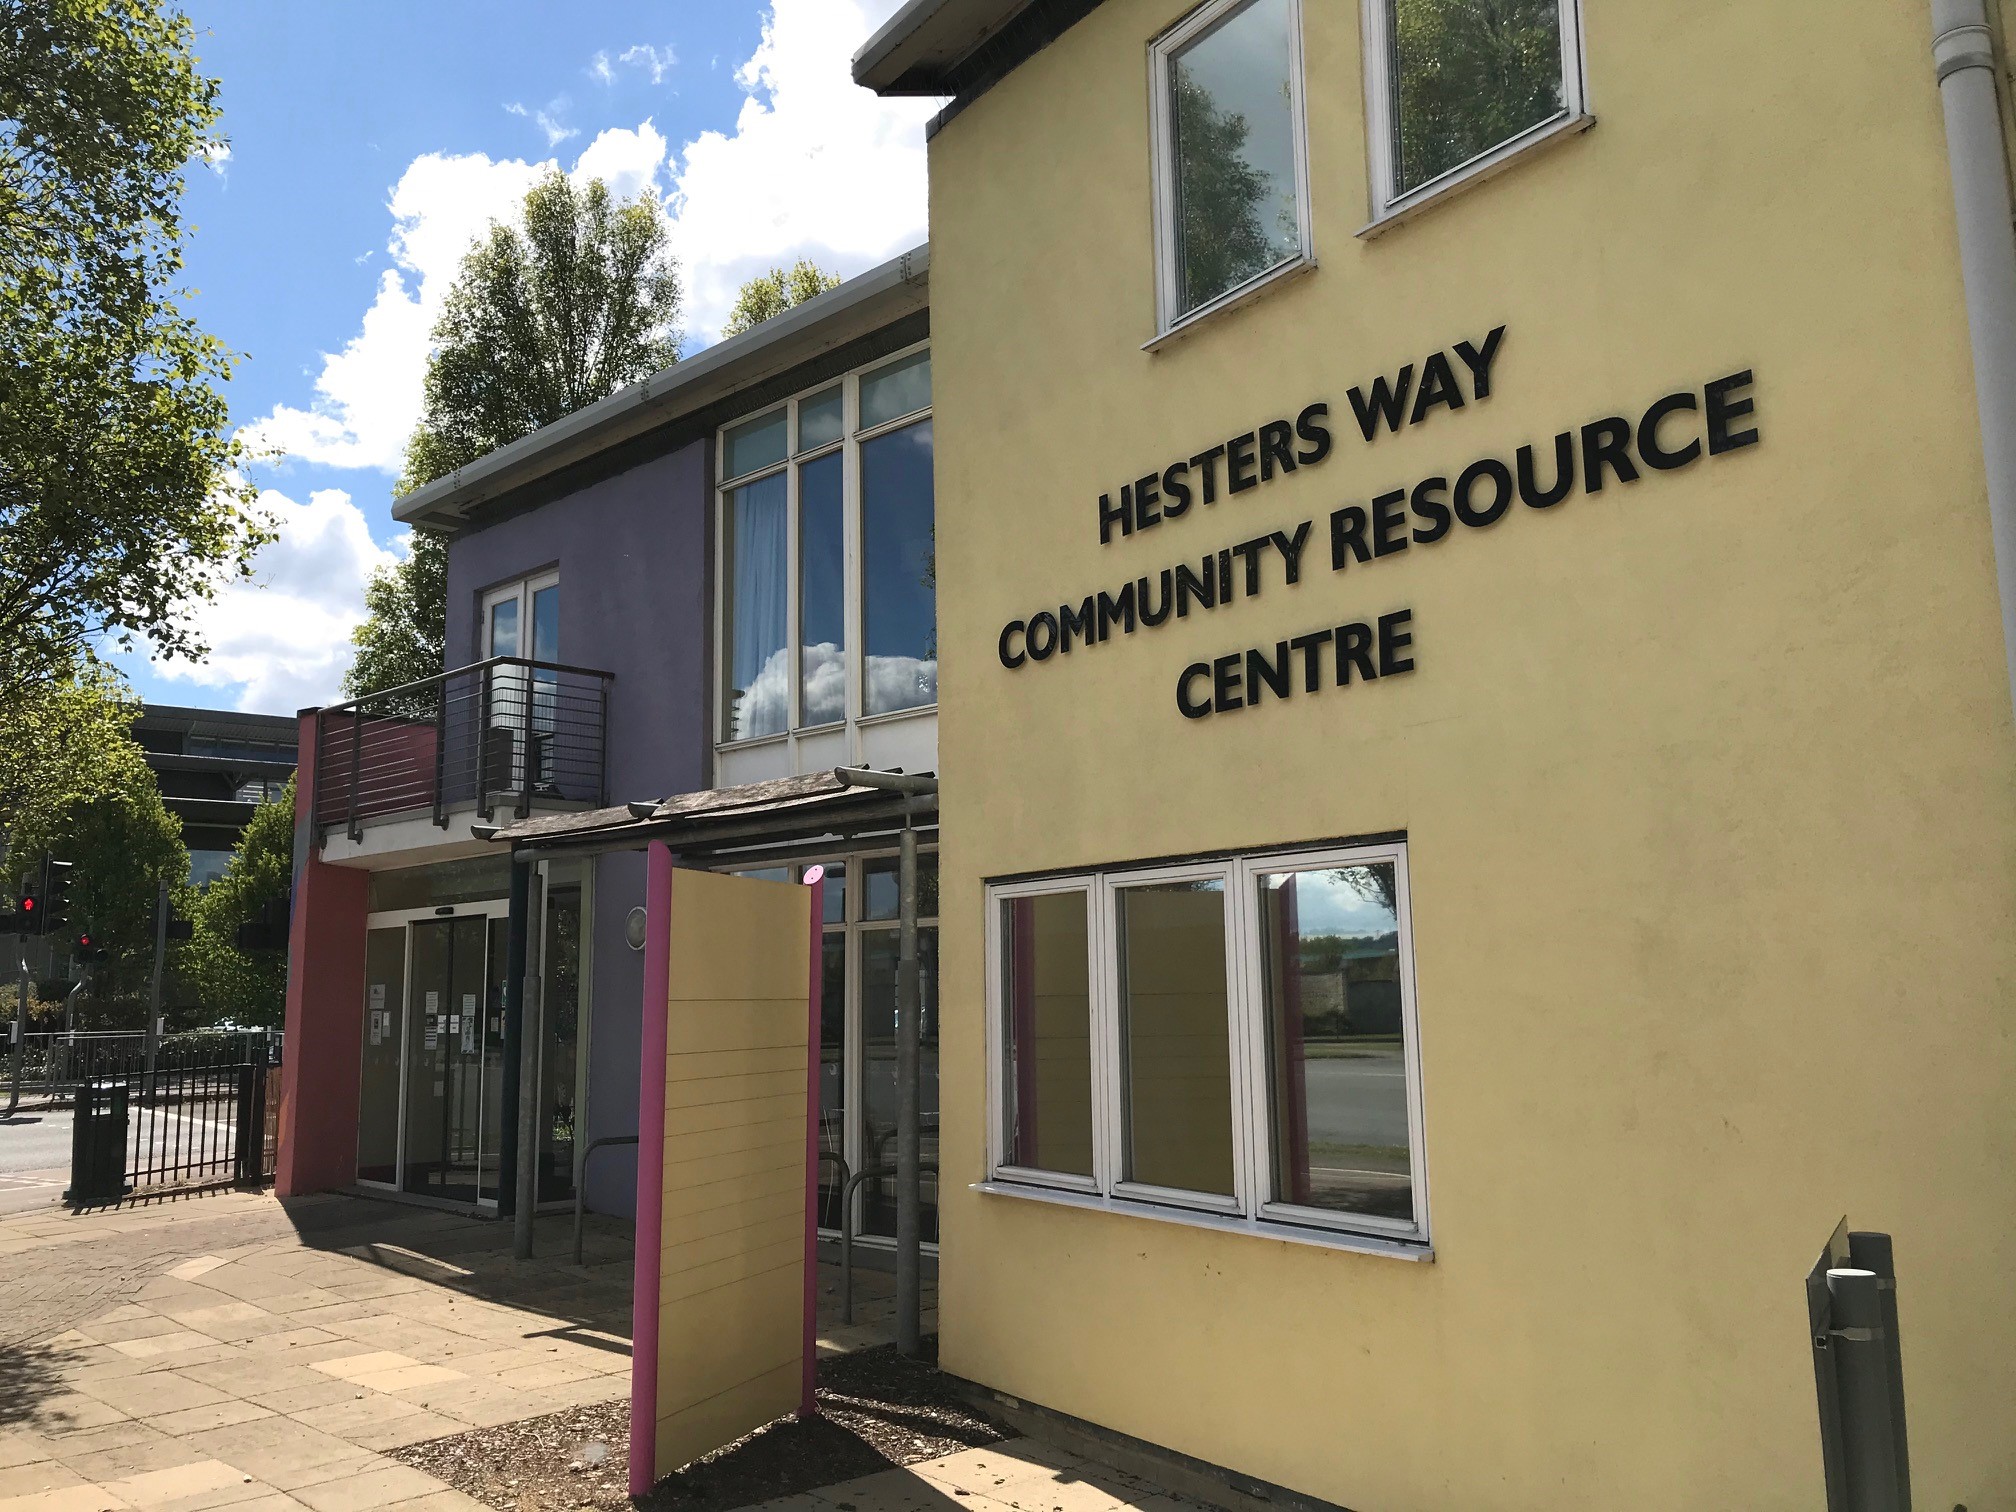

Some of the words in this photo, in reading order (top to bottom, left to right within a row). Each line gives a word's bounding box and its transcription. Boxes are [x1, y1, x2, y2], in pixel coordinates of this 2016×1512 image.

[999, 520, 1312, 671] COMMUNITY
[1330, 369, 1759, 571] RESOURCE
[1099, 403, 1333, 545] HESTERS
[1346, 325, 1506, 442] WAY
[1177, 609, 1414, 721] CENTRE
